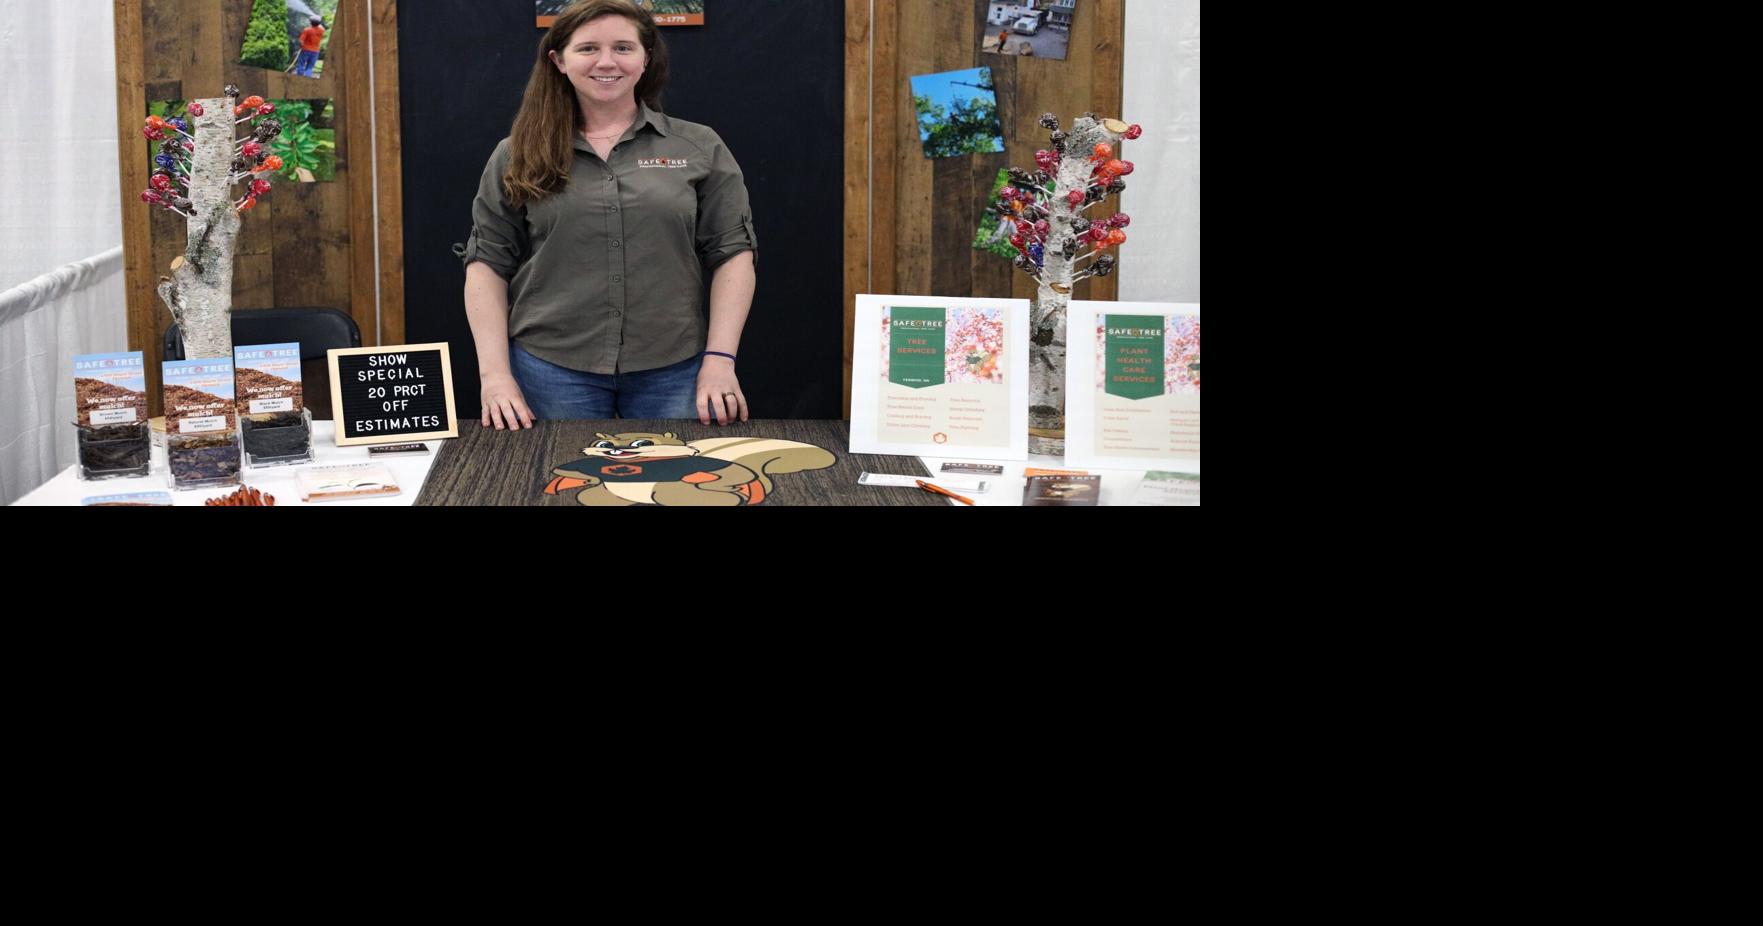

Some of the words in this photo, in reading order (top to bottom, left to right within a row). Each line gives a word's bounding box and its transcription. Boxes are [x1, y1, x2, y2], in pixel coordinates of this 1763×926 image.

[369, 354, 407, 367] SHOW
[358, 367, 424, 381] SPECIAL
[368, 387, 386, 399] 20
[393, 384, 426, 397] PRCT
[382, 400, 409, 412] OFF
[355, 415, 440, 432] ESTIMATES
